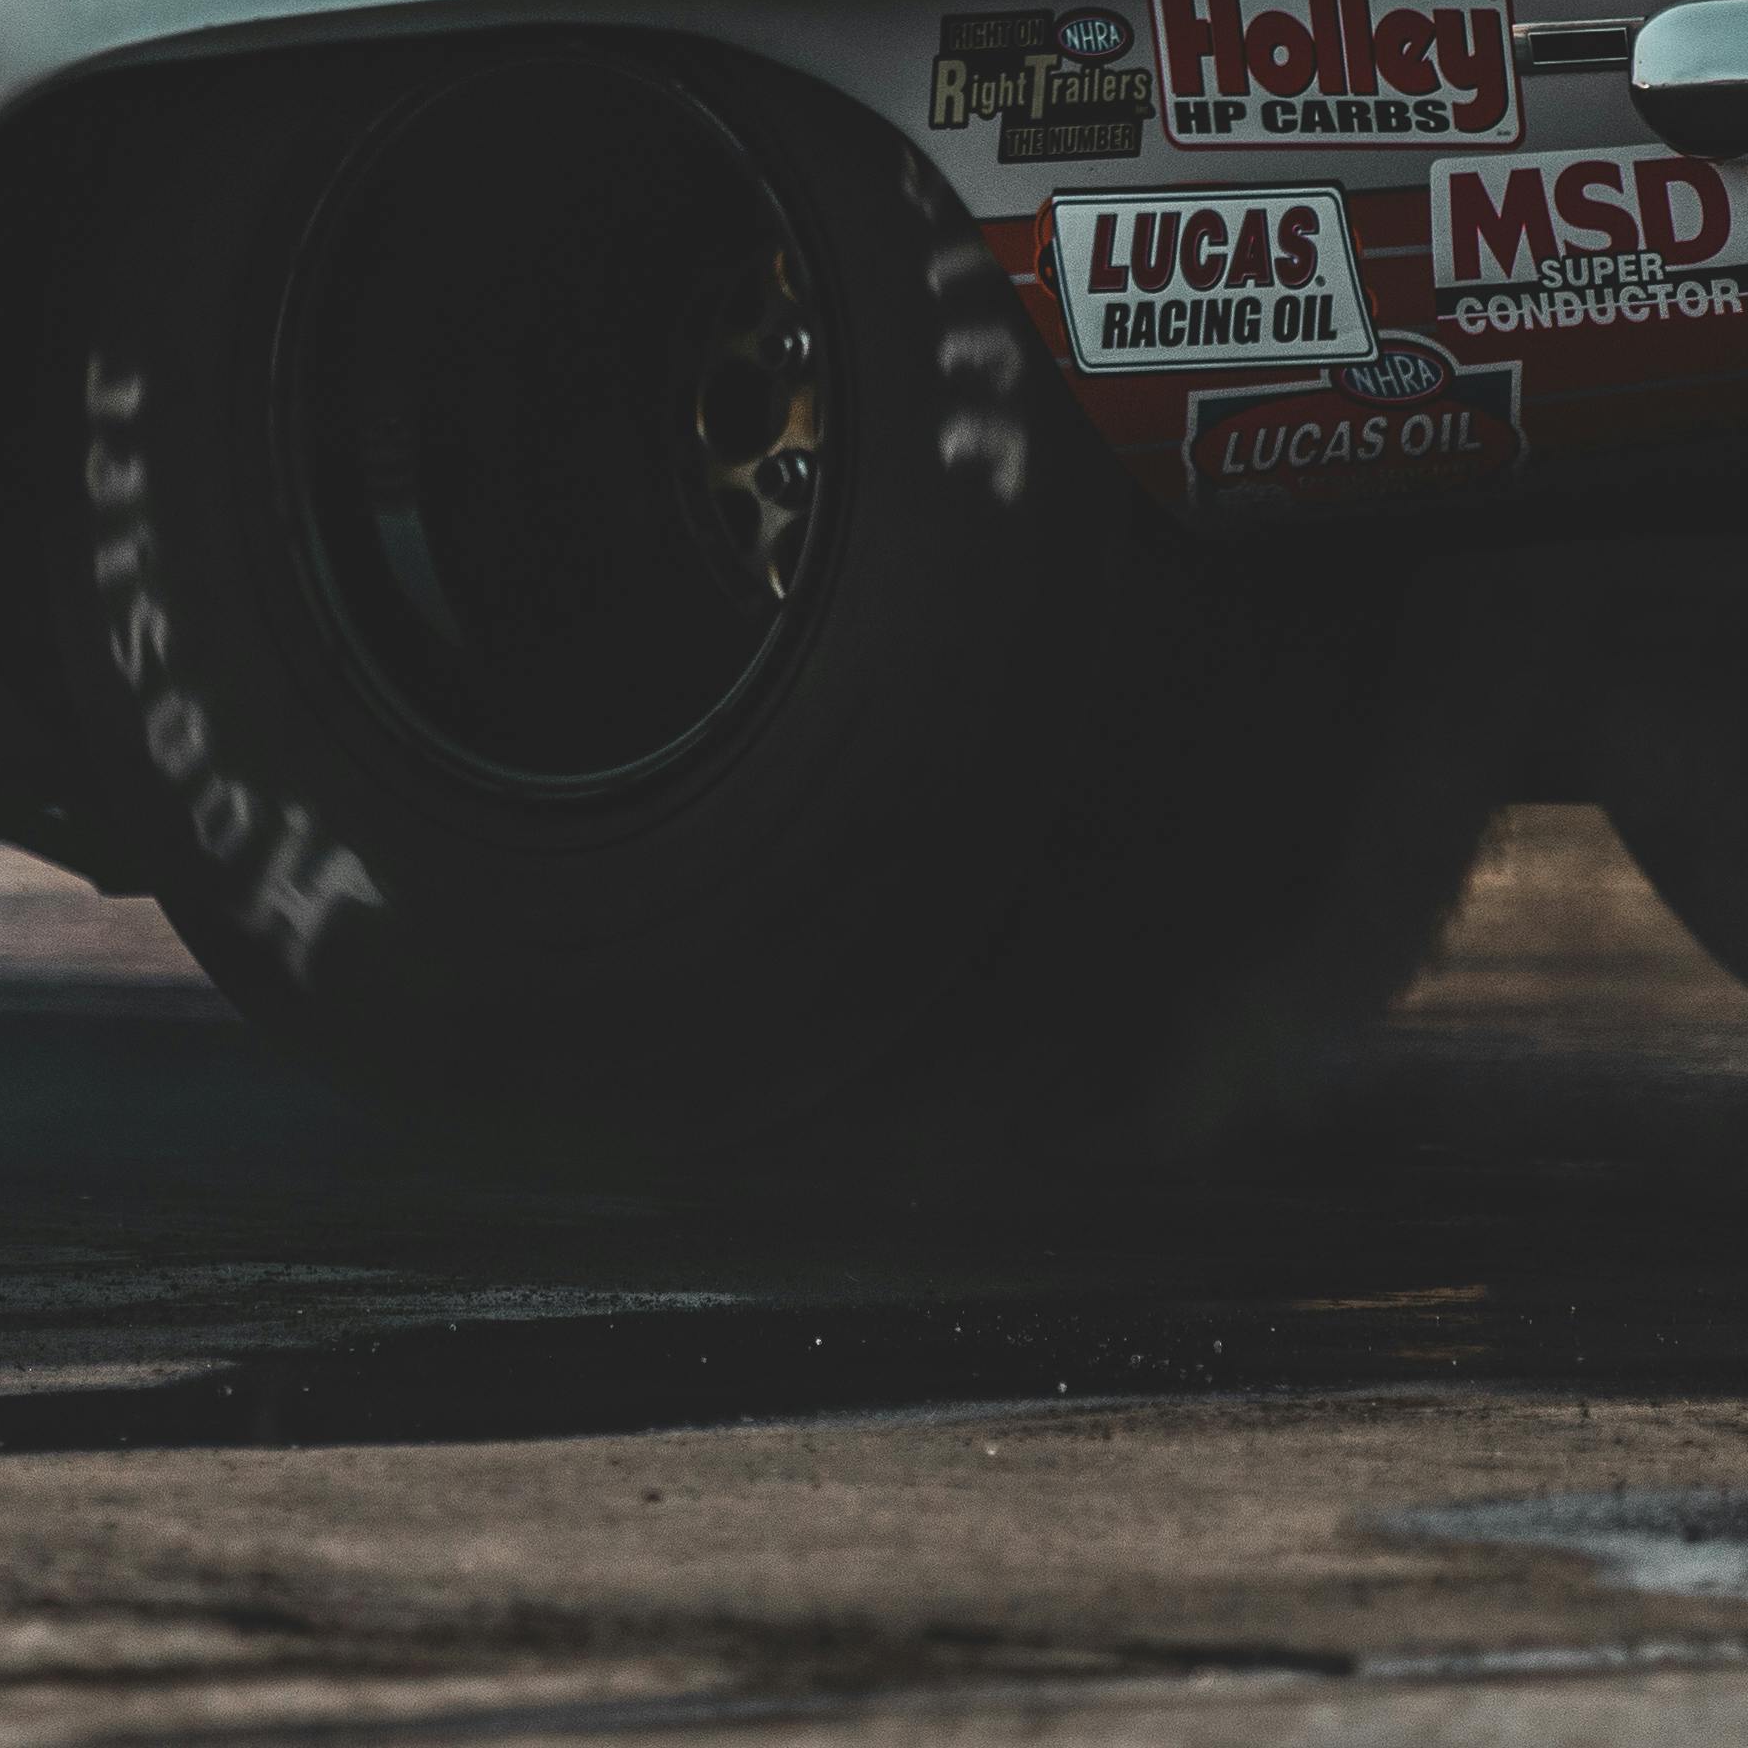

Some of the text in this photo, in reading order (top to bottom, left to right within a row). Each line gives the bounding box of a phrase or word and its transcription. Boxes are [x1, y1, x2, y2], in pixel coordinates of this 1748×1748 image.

[952, 18, 1045, 50] RIGHT ON
[1065, 20, 1121, 52] NHRA
[1174, 100, 1247, 134] HP
[1261, 99, 1452, 134] CARBS
[1006, 124, 1135, 157] THE NUMBER
[1449, 156, 1732, 282] MSD
[1087, 205, 1320, 294] LUCAS
[1539, 252, 1665, 288] SUPER
[1101, 294, 1338, 349] RACING OIL
[1455, 278, 1743, 334] CONDUCTOR
[1351, 354, 1436, 397] NHRA
[1220, 411, 1483, 475] LUCAS OIL
